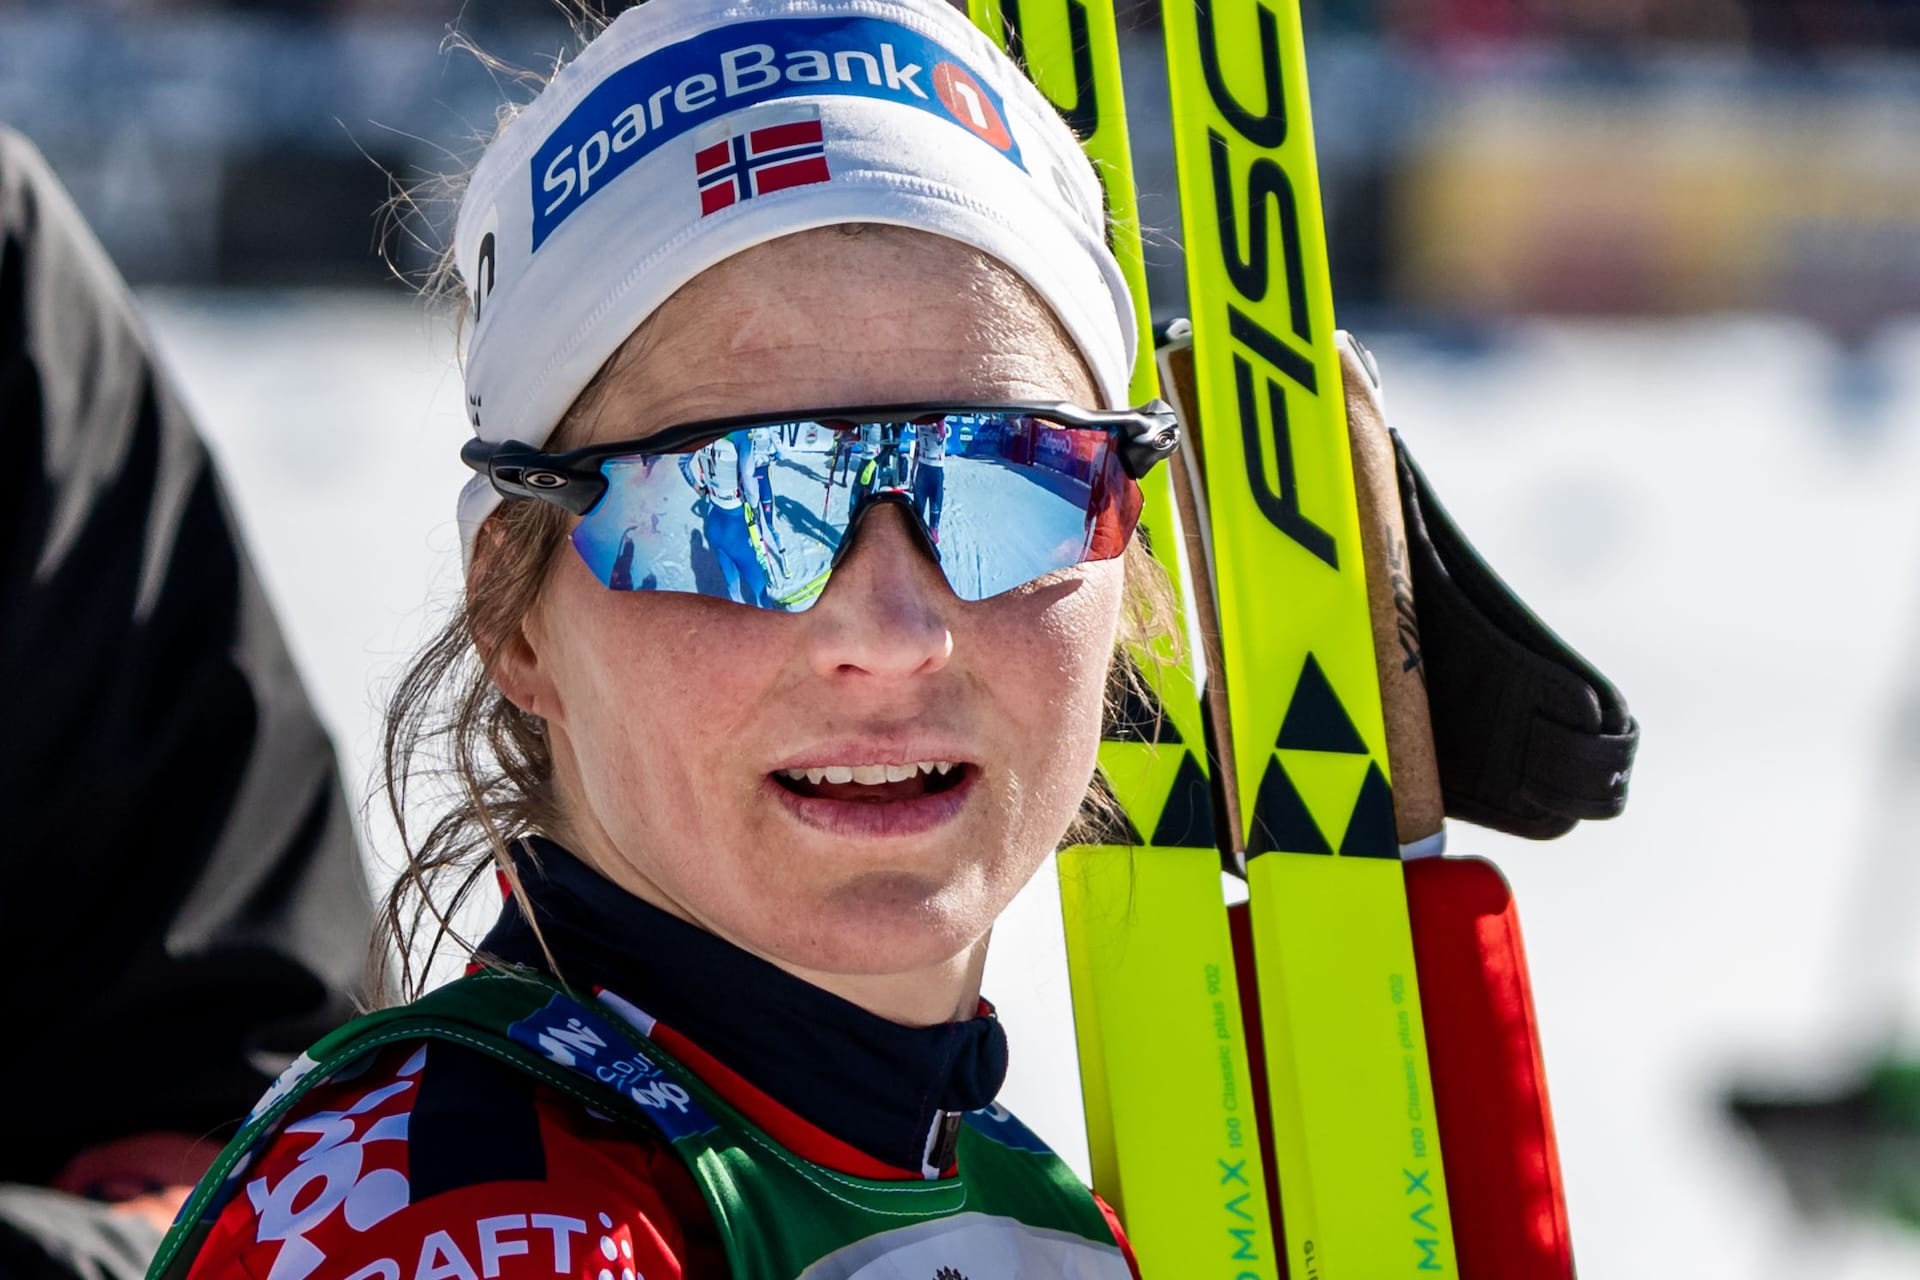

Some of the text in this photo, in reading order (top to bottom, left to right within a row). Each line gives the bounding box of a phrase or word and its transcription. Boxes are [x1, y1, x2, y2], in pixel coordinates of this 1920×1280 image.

[543, 42, 929, 217] SpareBank
[1212, 1000, 1232, 1041] plus
[1218, 1044, 1239, 1112] Classic
[1225, 1116, 1244, 1149] 100
